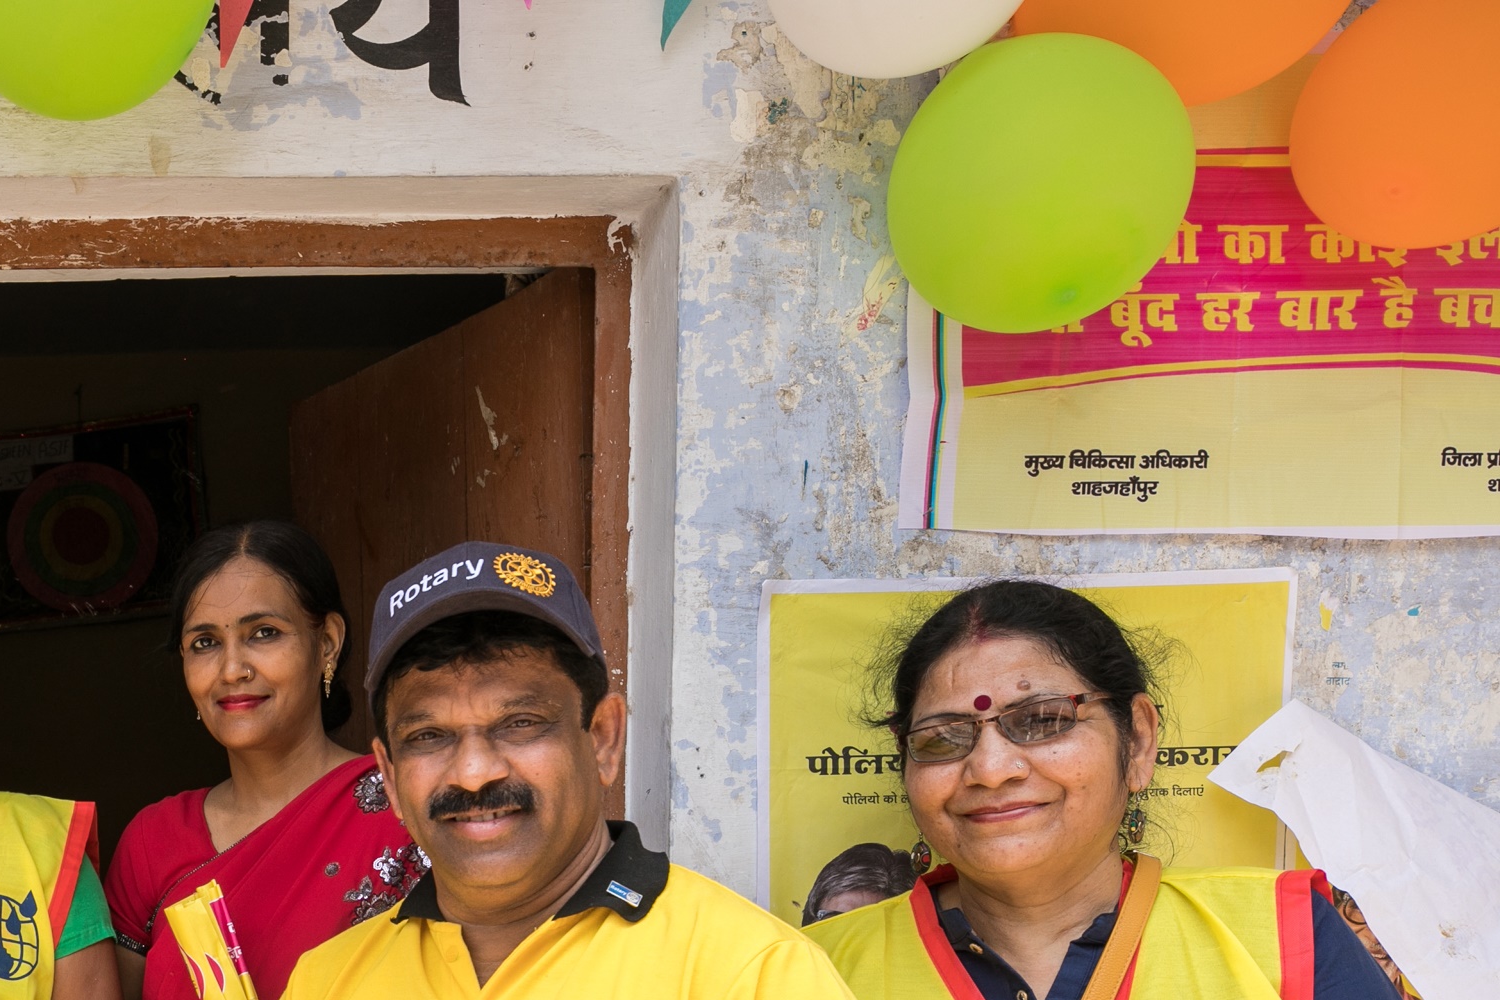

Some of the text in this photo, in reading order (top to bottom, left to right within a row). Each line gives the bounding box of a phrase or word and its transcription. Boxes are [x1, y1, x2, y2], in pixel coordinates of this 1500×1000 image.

[1218, 224, 1289, 264] का
[1196, 291, 1261, 332] हर
[1275, 288, 1364, 331] बार
[1370, 275, 1418, 329] है
[1024, 448, 1210, 478] मुख्य चिकित्सा अधिकारी
[1440, 446, 1484, 467] जिला
[1071, 475, 1160, 503] शाहजहाँपुर
[388, 558, 485, 618] Rotary
[842, 792, 880, 805] पोलियो
[883, 791, 898, 804] को
